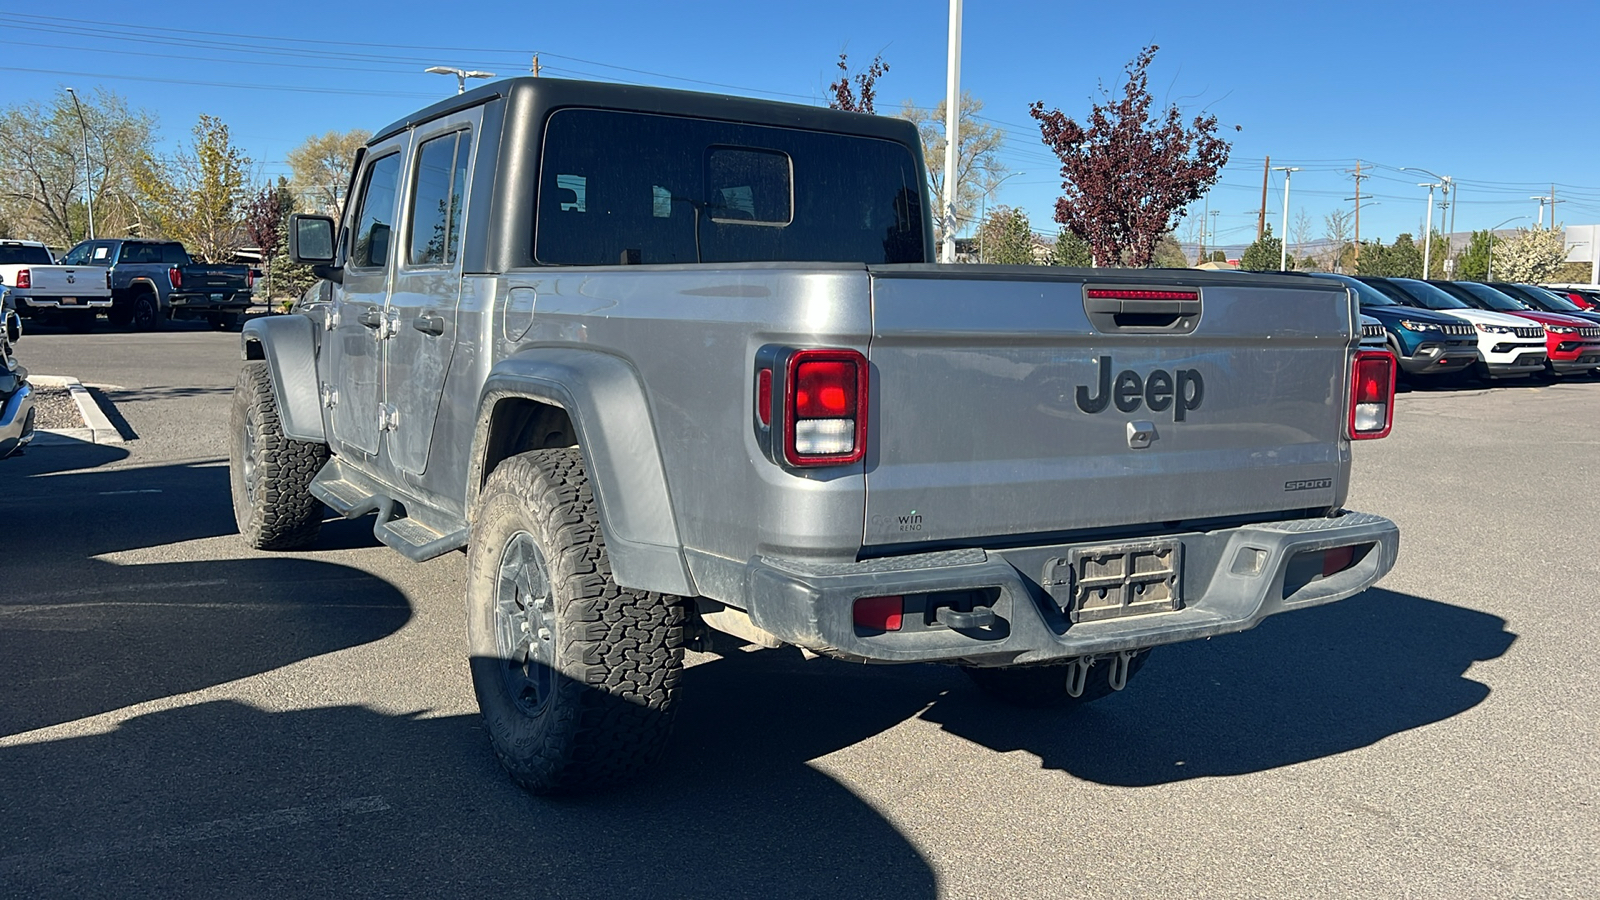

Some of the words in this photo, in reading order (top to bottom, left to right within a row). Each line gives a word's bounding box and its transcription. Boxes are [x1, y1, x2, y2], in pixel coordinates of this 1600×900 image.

[1075, 355, 1204, 422] Jeep
[1284, 478, 1332, 491] SPORT
[899, 524, 922, 532] RENO
